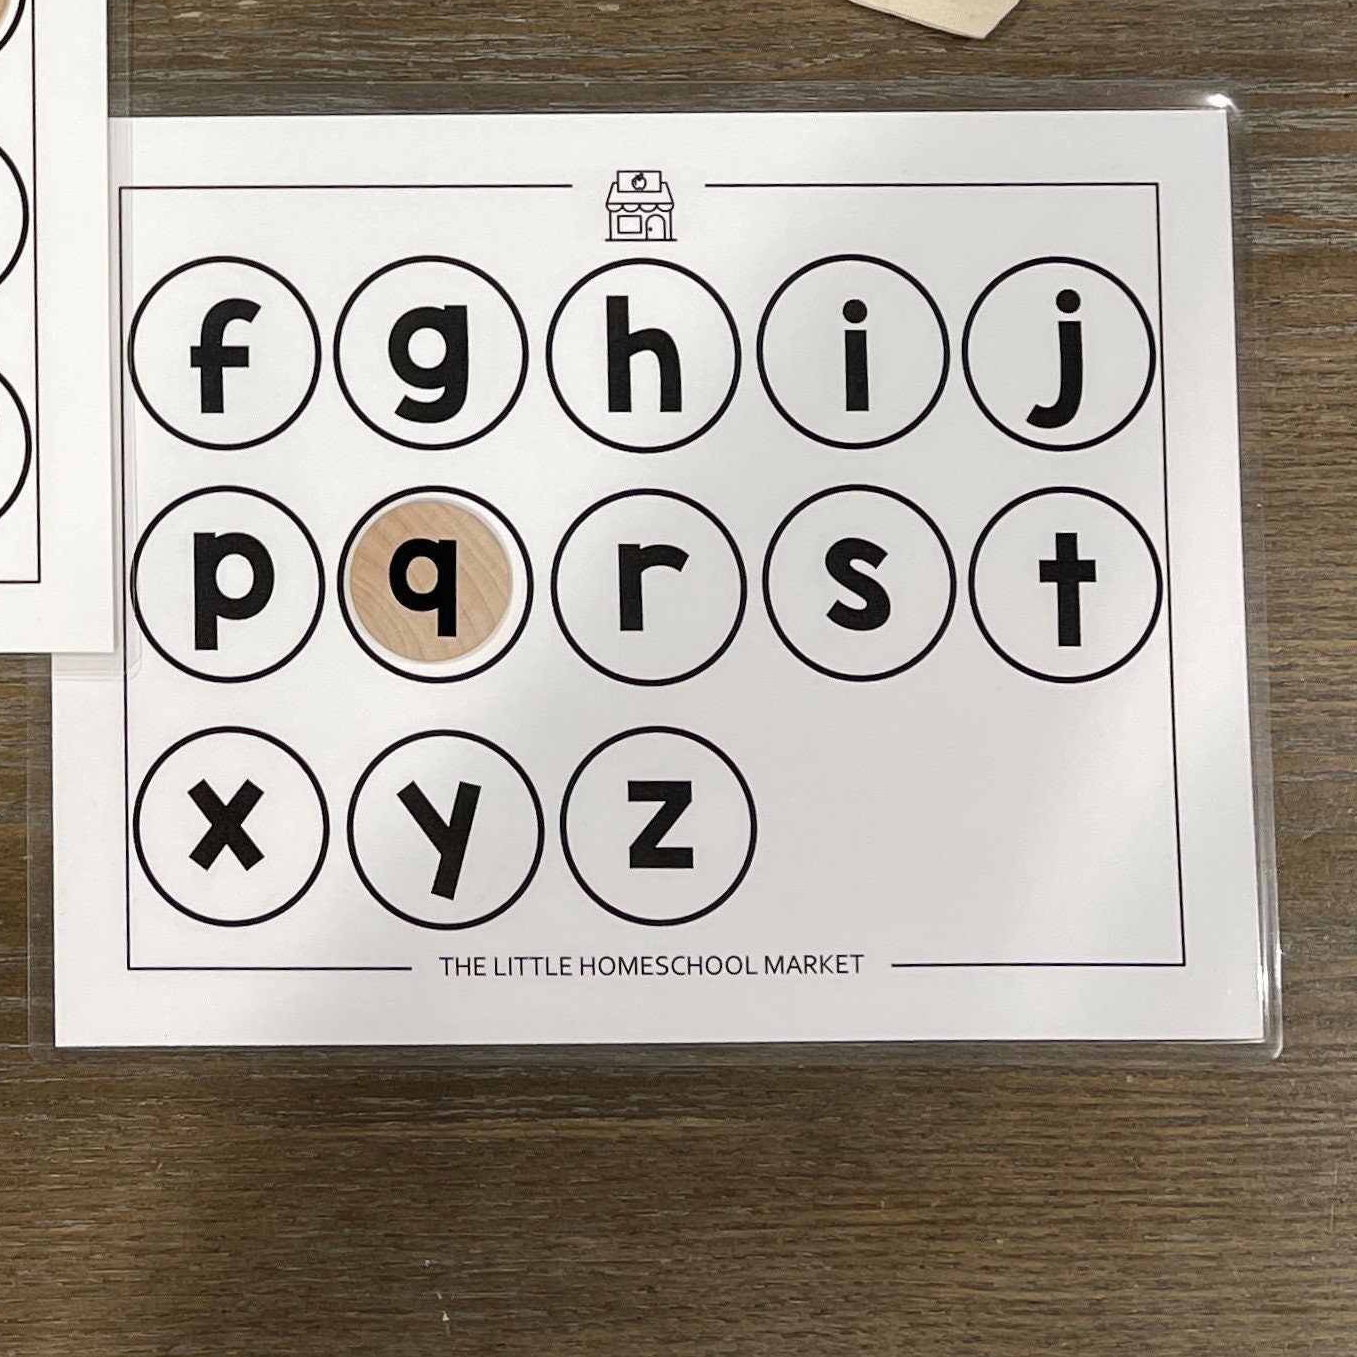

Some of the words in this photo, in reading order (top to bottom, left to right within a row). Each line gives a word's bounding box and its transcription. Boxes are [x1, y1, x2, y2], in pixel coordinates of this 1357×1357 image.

[191, 299, 261, 413] f
[389, 305, 468, 423] g
[607, 296, 681, 412] h
[843, 300, 868, 411] i
[1028, 290, 1082, 429] j
[194, 533, 274, 649] p
[389, 539, 456, 637] q
[619, 544, 689, 631] r
[825, 538, 890, 631] s
[1039, 533, 1096, 646] t
[188, 779, 264, 870] x
[397, 781, 481, 901] y
[628, 781, 693, 868] z
[439, 957, 486, 976] THE
[495, 957, 572, 976] LITTLE
[580, 956, 758, 976] HOMESCHOOL
[765, 955, 864, 974] MARKET
